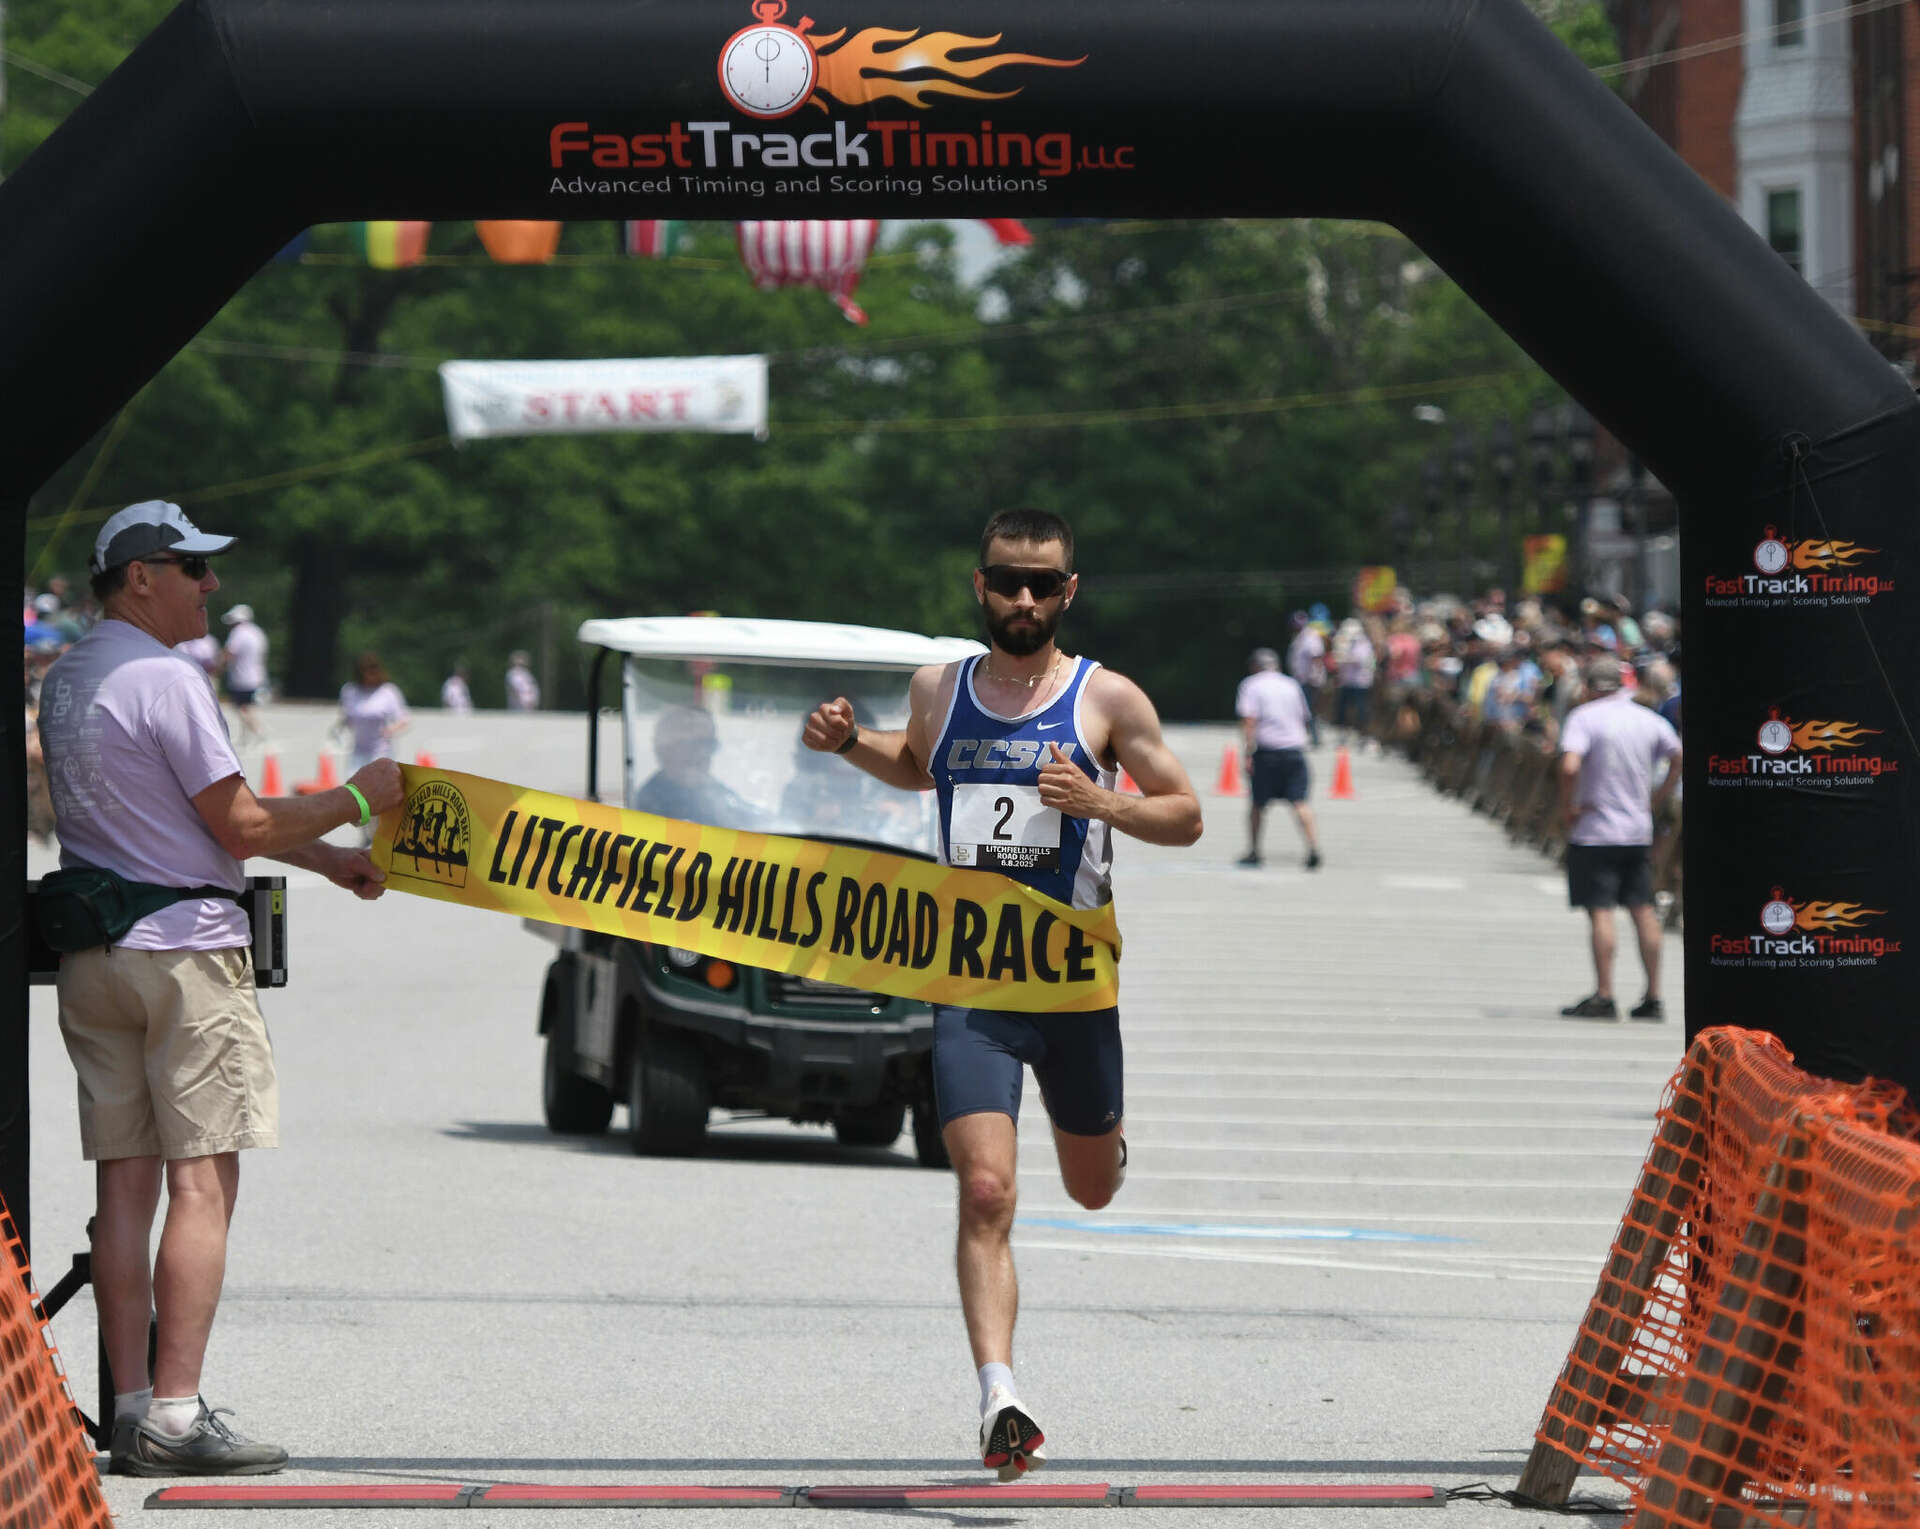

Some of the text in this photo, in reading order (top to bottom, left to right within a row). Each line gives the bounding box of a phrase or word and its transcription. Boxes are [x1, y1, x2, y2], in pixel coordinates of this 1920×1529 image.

[550, 175, 1049, 197] Advanced Timing and Scoring Solutions
[525, 388, 692, 424] START
[1705, 595, 1871, 608] Advanced Timing an Scoring Soluions
[1708, 776, 1874, 788] Advanced Timing and Scoring Solutions
[432, 783, 453, 799] HILLS
[450, 793, 465, 817] ROAD
[993, 797, 1014, 841] 2
[985, 846, 1051, 855] LITCHFIELD HILLS
[997, 853, 1039, 862] ROAD RACE
[488, 811, 1096, 983] LITCHFIELD HILLS ROAD RACE
[1710, 956, 1877, 968] Advanced Timing and Scoring Solutions
